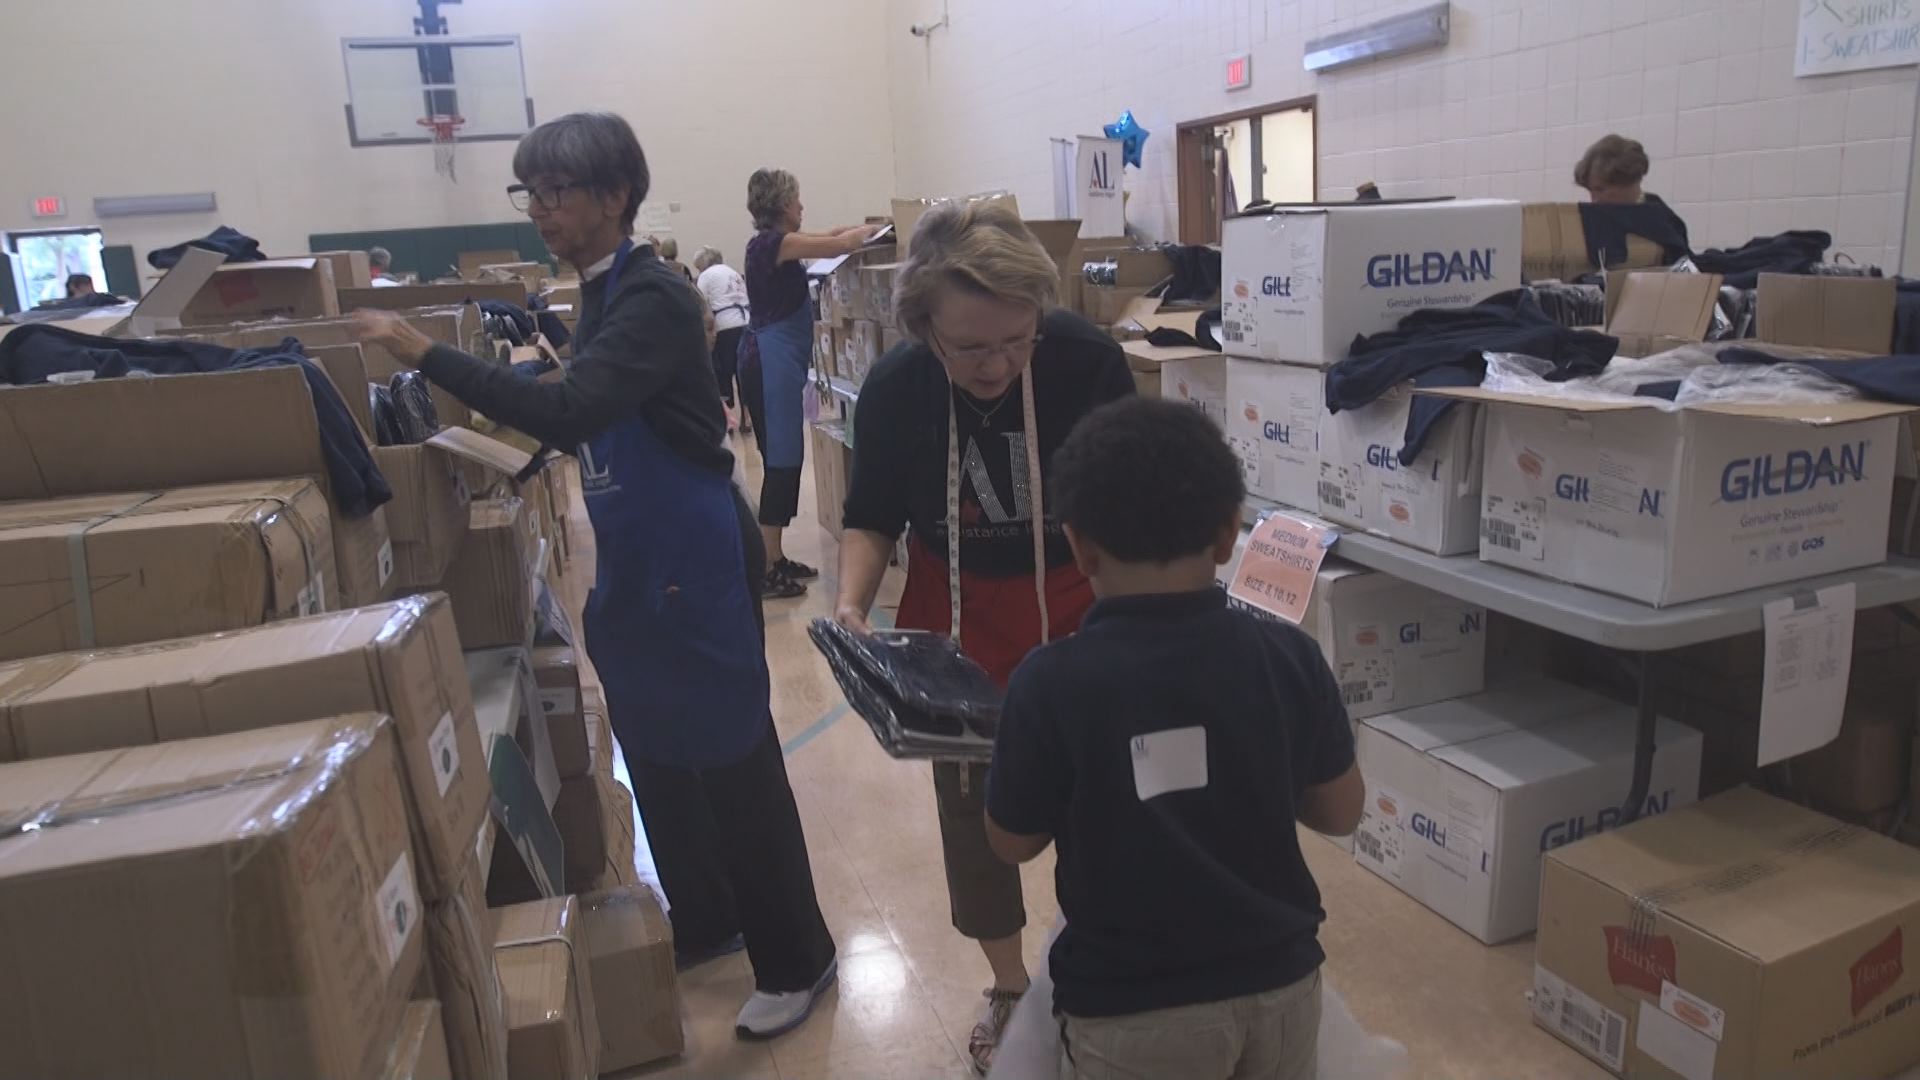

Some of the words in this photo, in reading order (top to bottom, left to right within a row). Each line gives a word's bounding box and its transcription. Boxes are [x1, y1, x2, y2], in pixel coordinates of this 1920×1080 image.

[1088, 150, 1115, 189] AL
[1367, 248, 1491, 288] GILDAN
[1720, 440, 1865, 502] GILDAN
[1250, 539, 1314, 572] SWEATSHIRTS
[1271, 528, 1309, 549] MEDIUM
[1243, 574, 1265, 593] SIZE
